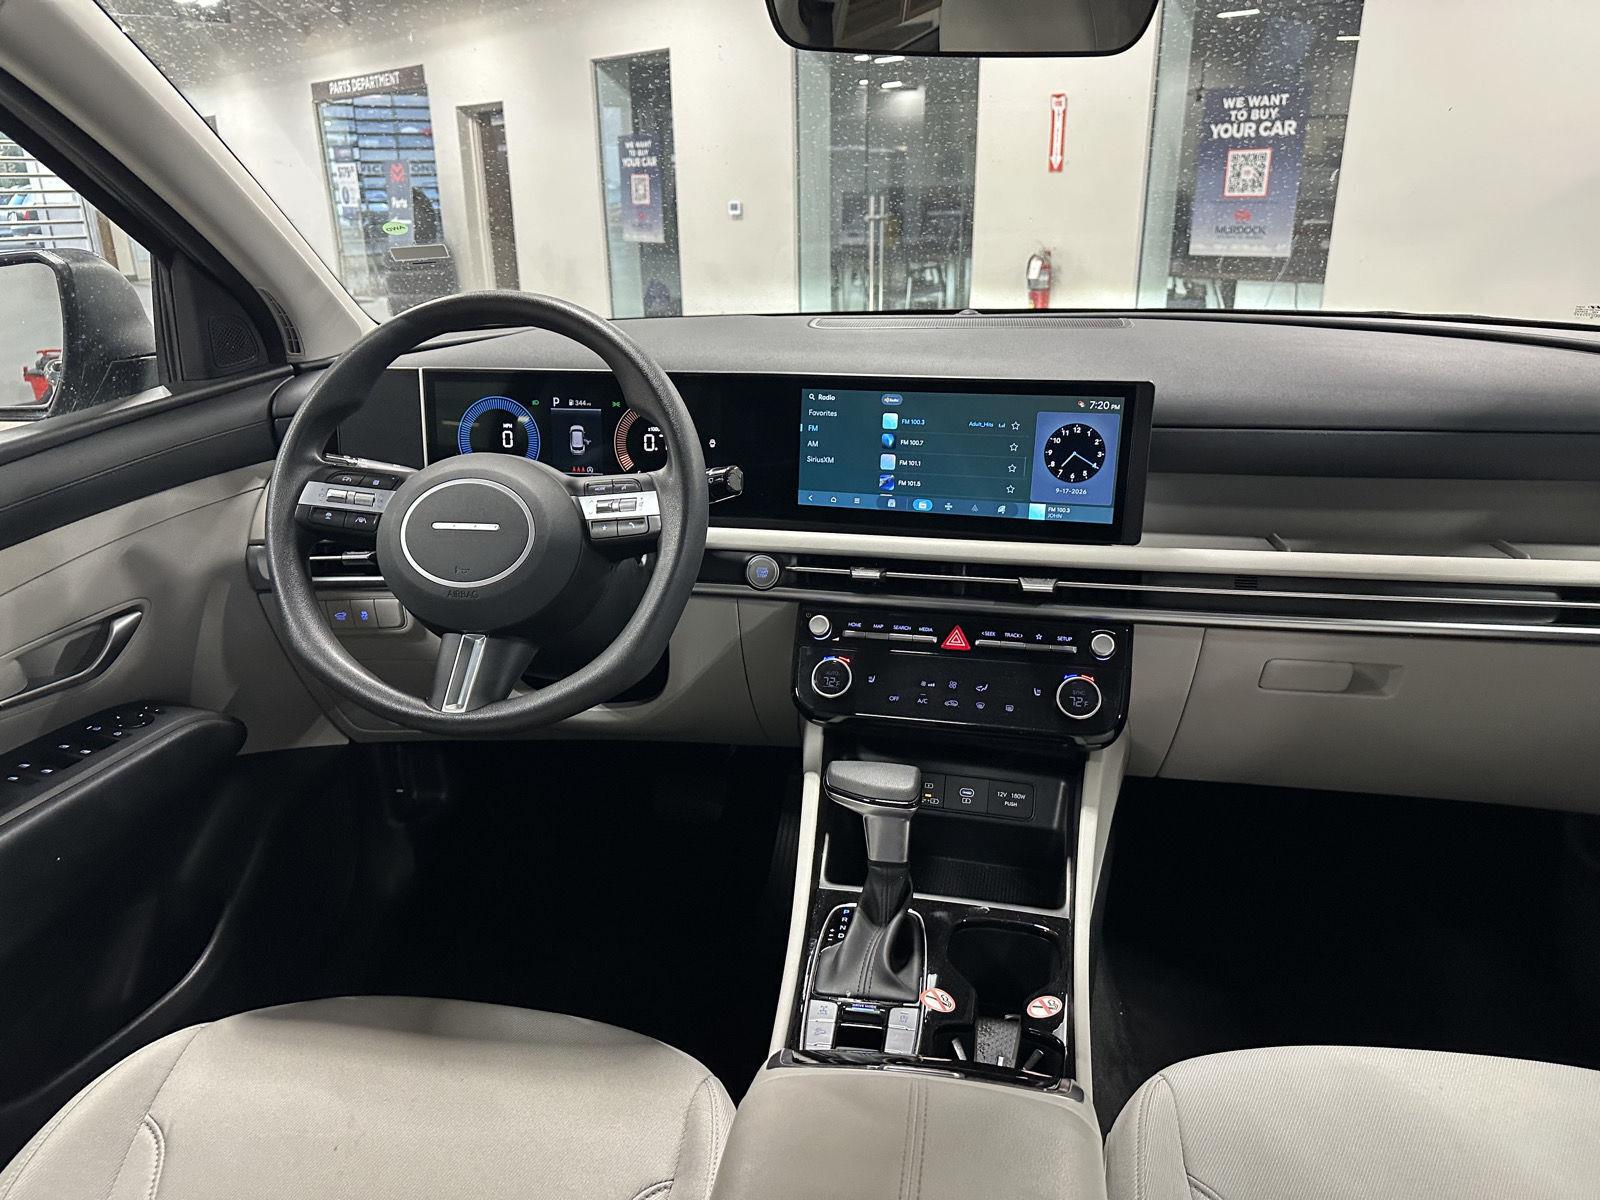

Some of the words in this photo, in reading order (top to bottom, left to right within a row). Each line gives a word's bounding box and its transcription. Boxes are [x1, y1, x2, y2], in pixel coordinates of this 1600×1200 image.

[328, 80, 351, 95] PARTS
[351, 71, 400, 92] DEPARTMENT
[1223, 97, 1245, 109] WE
[1247, 93, 1289, 107] WANT
[1230, 110, 1248, 121] TO
[1250, 107, 1280, 121] BUY
[1210, 121, 1257, 139] YOUR
[1259, 119, 1297, 137] CAR
[552, 396, 560, 407] P
[818, 393, 836, 401] Radio
[1089, 400, 1110, 410] 7:20
[808, 408, 838, 417] Favorites
[807, 424, 819, 432] FM
[502, 430, 514, 448] 0
[806, 455, 835, 464] SiriusXM
[1050, 460, 1056, 468] 8
[1055, 487, 1087, 495] 9-17-2026
[447, 590, 480, 599] AIRBAG
